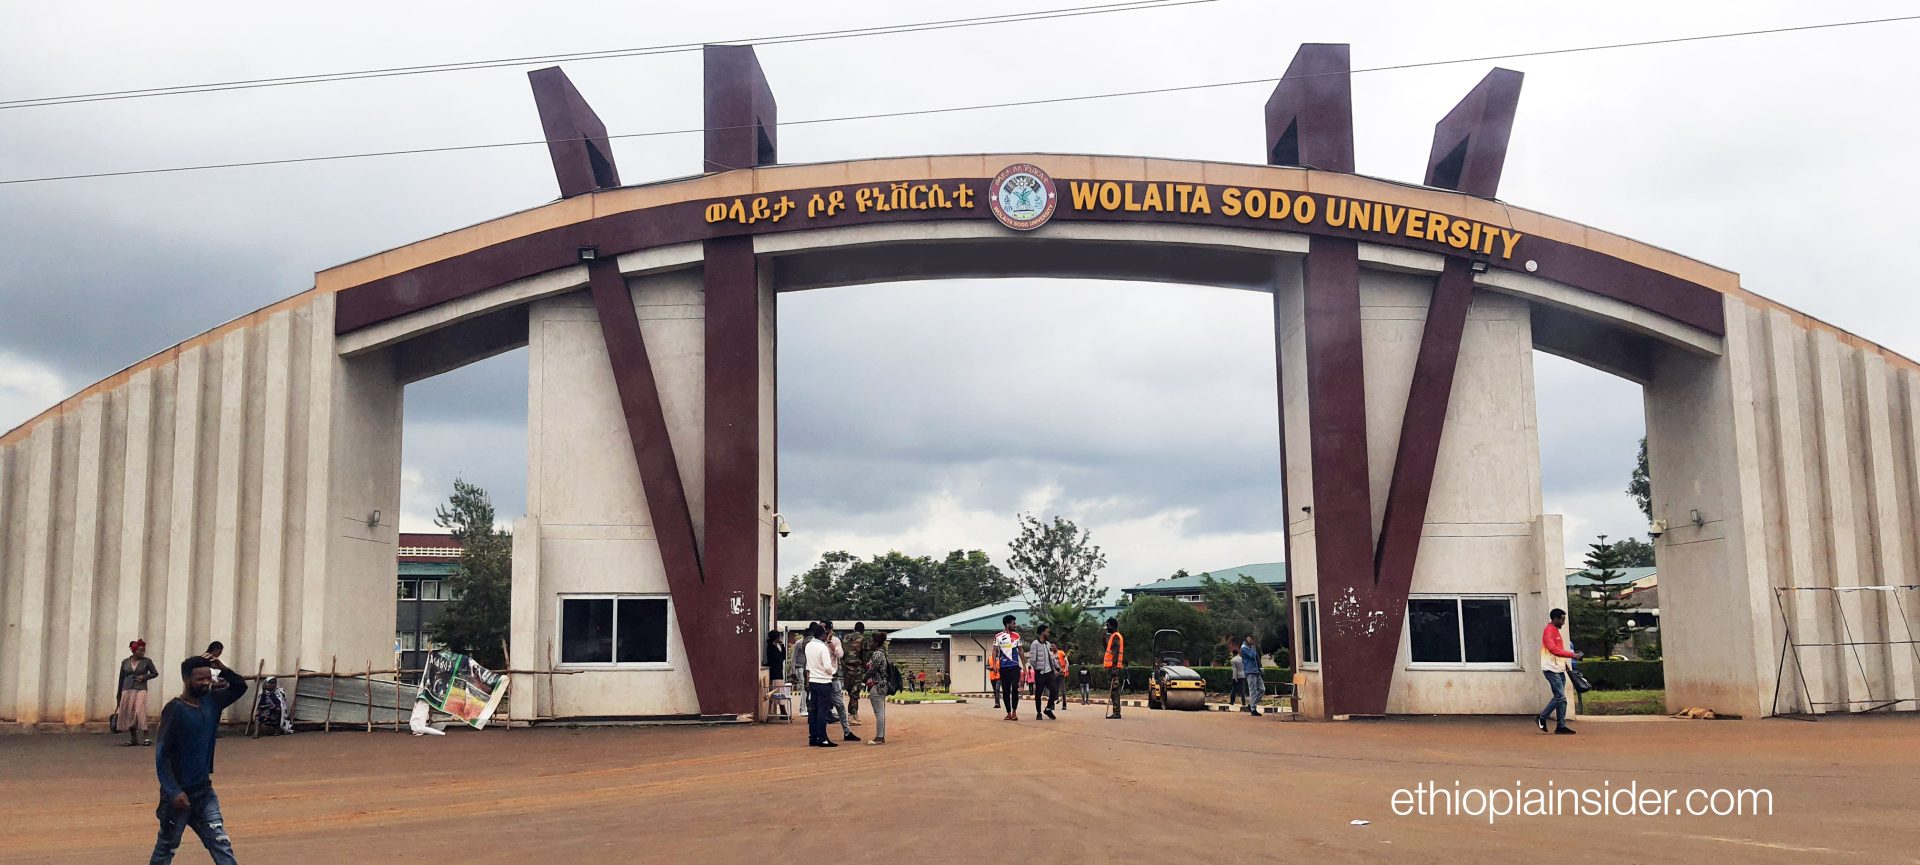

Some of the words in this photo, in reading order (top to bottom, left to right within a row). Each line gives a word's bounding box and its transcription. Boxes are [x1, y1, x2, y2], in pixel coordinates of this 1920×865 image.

[704, 195, 796, 224] ወላይታ
[807, 190, 846, 218] ሶዶ
[855, 182, 974, 213] ዩኒቨርሲቲ
[1070, 181, 1212, 214] WOLAITA
[1221, 187, 1317, 224] SODO
[1325, 197, 1522, 259] UNIVERSITY
